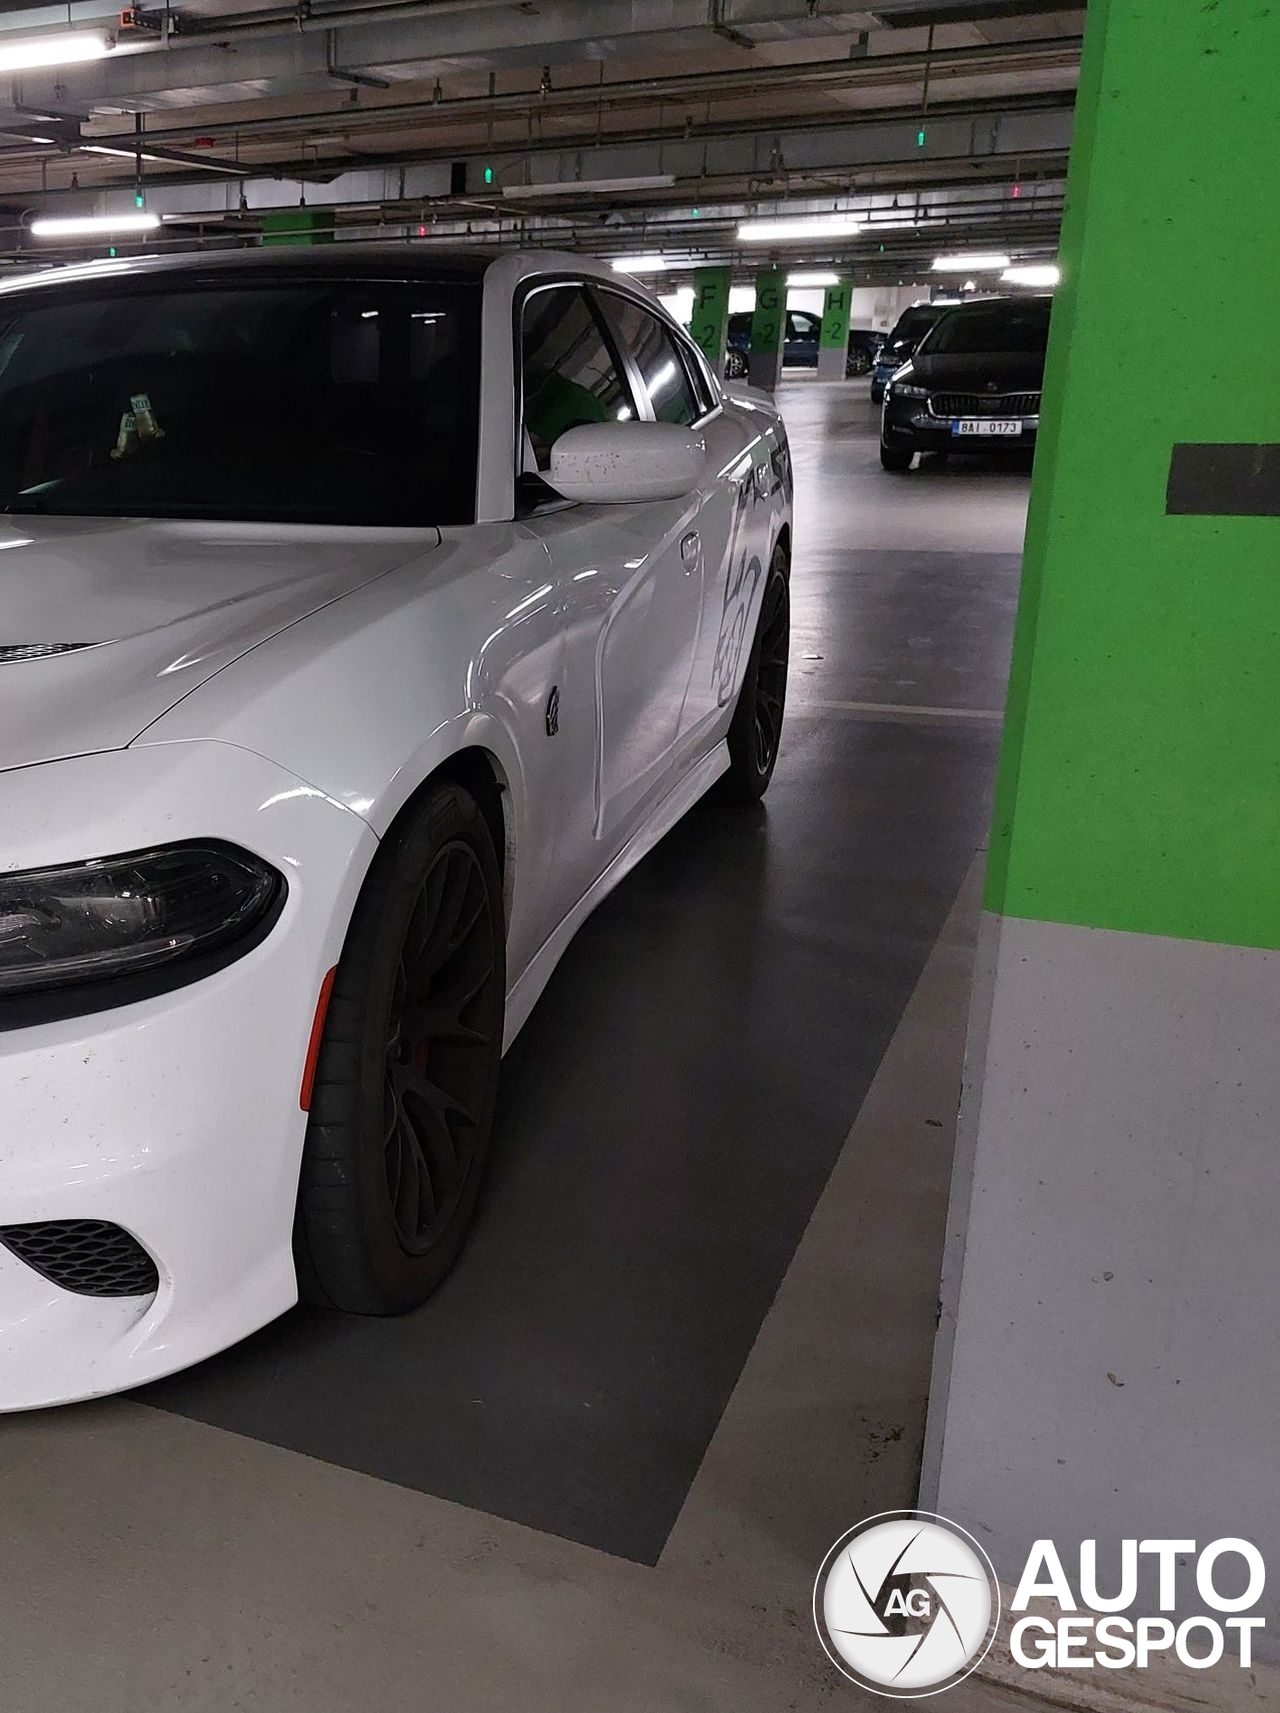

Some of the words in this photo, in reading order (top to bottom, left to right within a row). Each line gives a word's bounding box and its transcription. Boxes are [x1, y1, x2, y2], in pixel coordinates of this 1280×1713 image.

[699, 284, 716, 309] F
[759, 288, 778, 310] G
[827, 291, 845, 310] H
[825, 322, 842, 340] -2
[989, 422, 1017, 433] 0173
